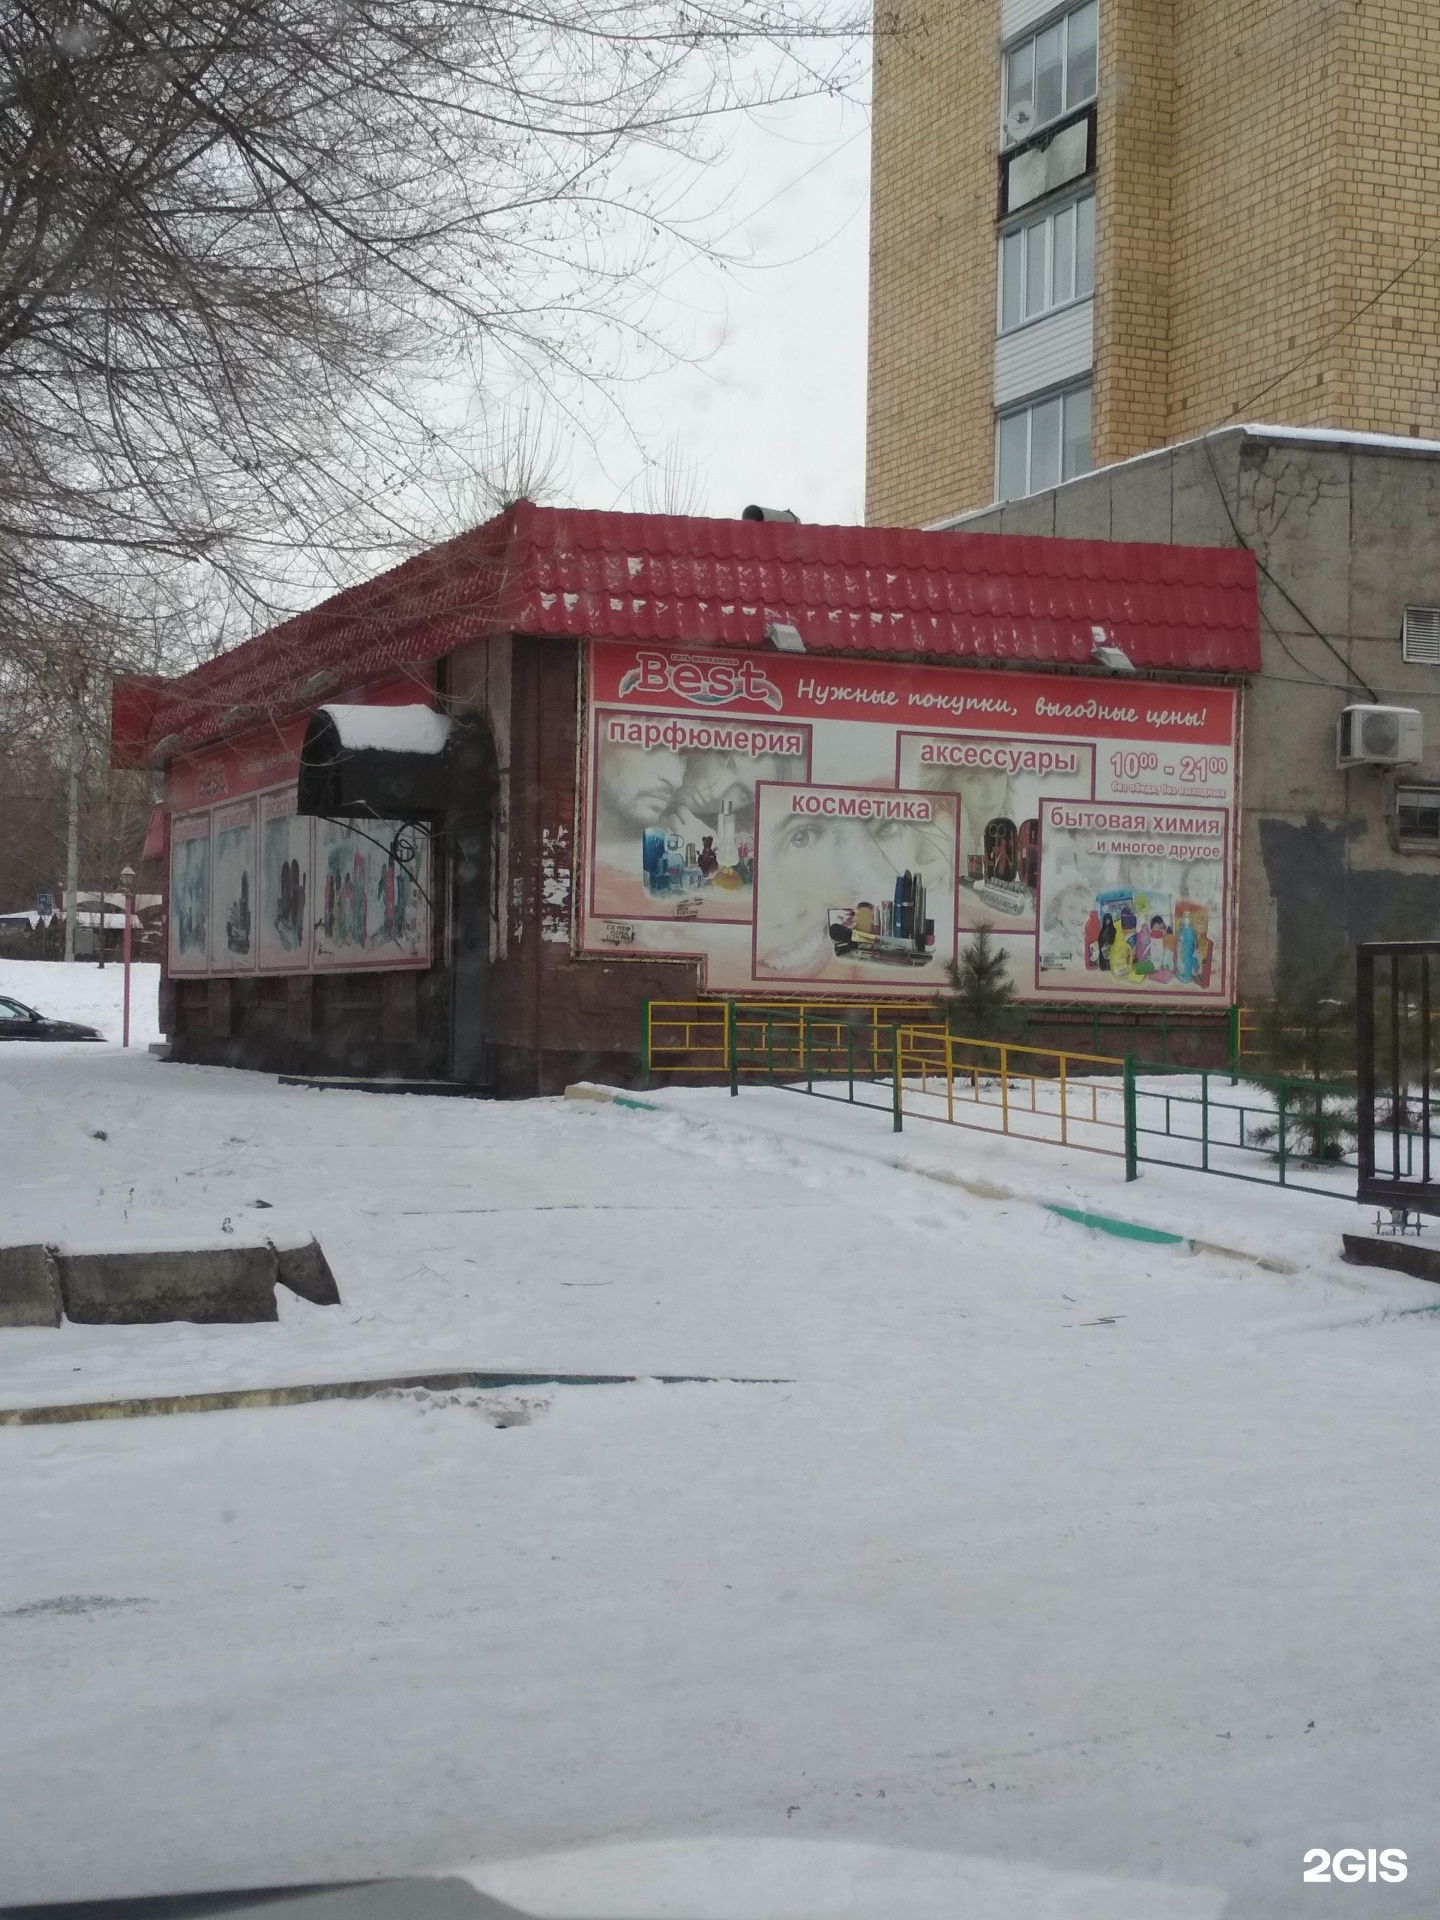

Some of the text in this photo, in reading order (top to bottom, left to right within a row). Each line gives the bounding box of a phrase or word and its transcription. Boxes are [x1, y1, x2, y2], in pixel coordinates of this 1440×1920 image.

[671, 653, 739, 666] сеть магазинов
[636, 652, 768, 700] Best
[797, 678, 1207, 728] Нужные покупки, выгодные цены!
[610, 721, 801, 757] парфюмерия
[920, 744, 1076, 774] аксессуары
[1111, 781, 1226, 799] без обеда, без выходных
[792, 795, 930, 820] косметика
[1051, 807, 1220, 834] бытовая химия
[1097, 841, 1221, 860] и многое другое
